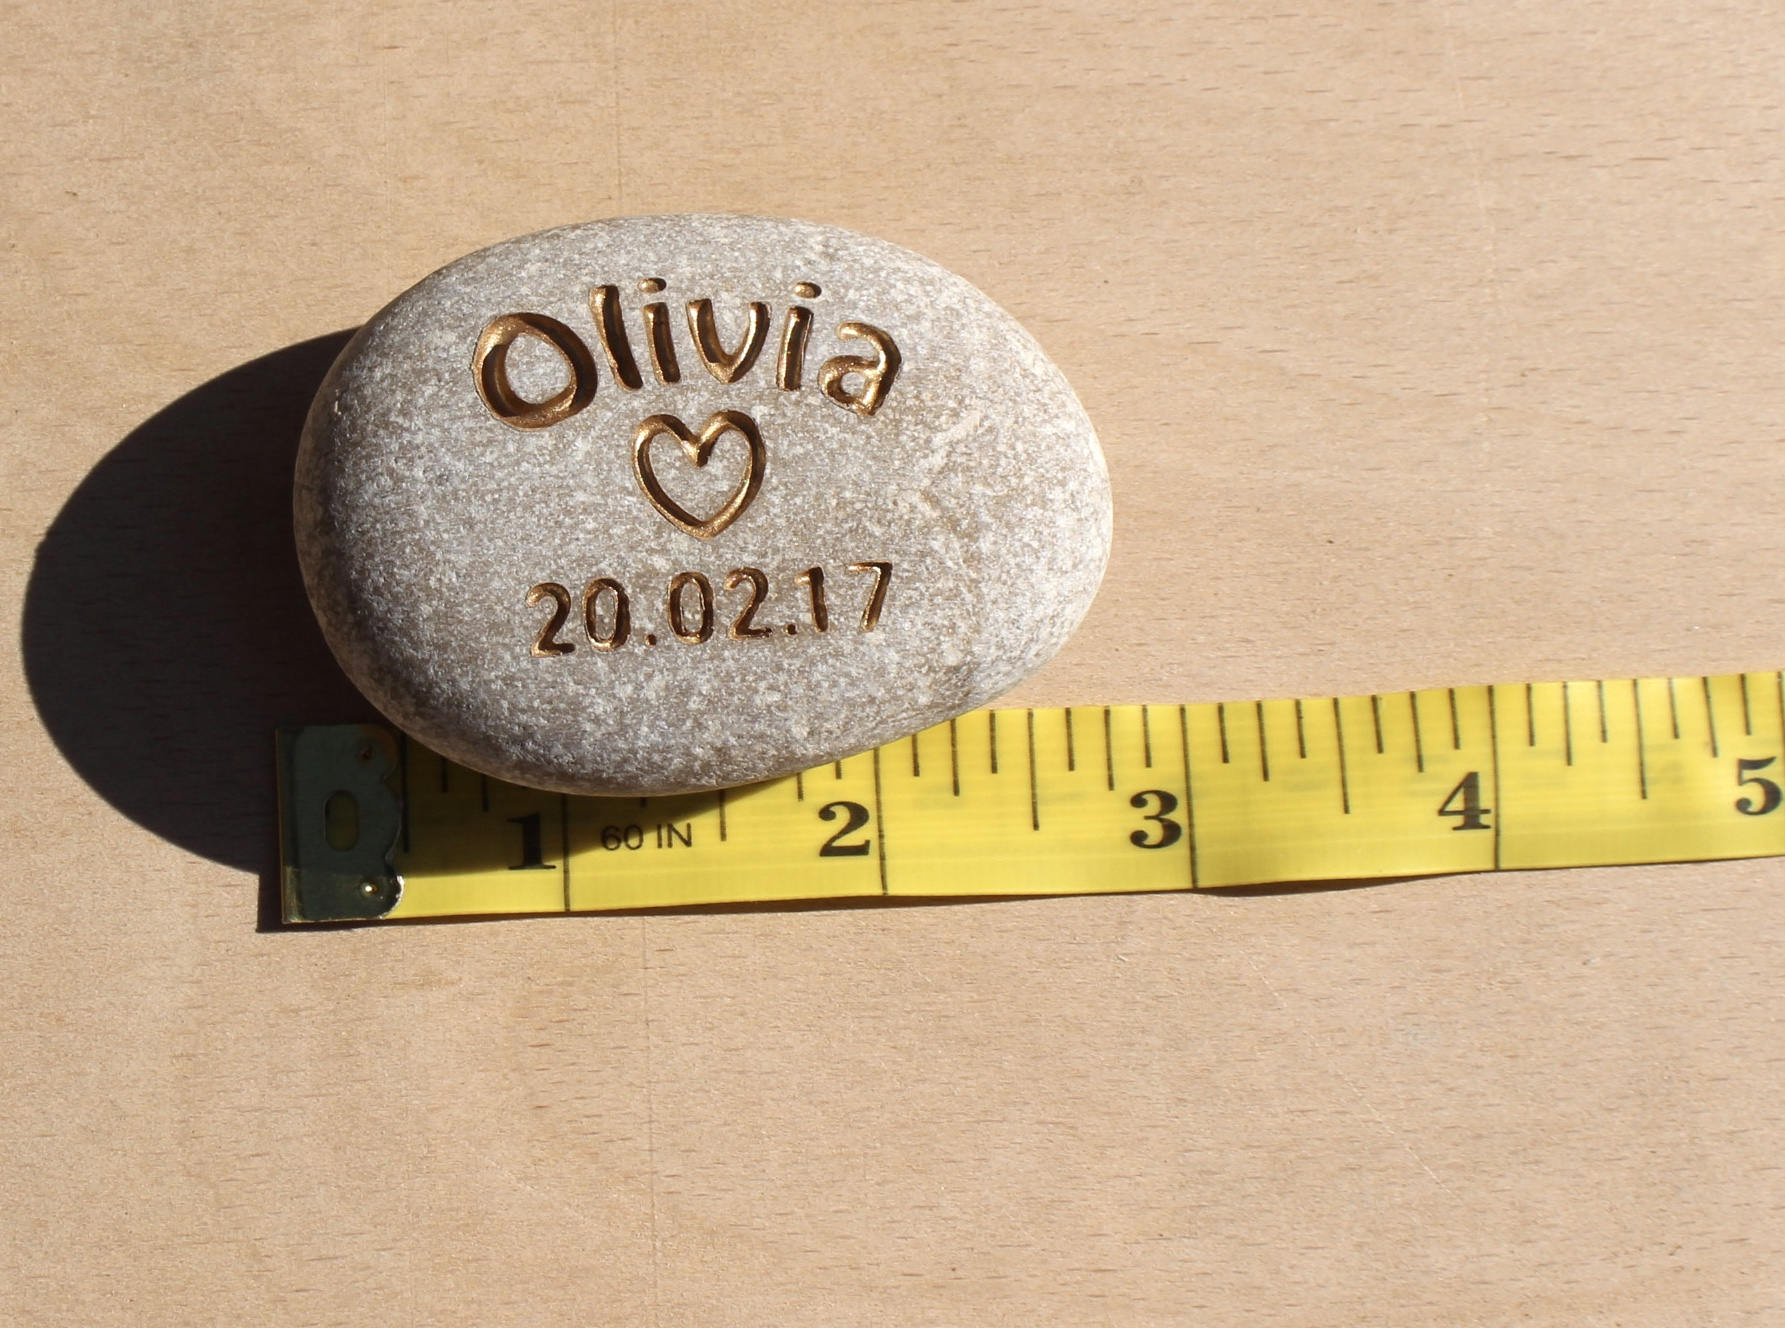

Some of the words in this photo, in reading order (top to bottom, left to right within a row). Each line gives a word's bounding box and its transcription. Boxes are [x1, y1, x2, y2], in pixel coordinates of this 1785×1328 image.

[472, 277, 902, 431] Olivia
[526, 561, 893, 657] 20.02.17
[1438, 771, 1492, 830] 4
[1734, 756, 1783, 816] 5
[508, 812, 557, 871] 1
[600, 822, 645, 851] 60
[656, 821, 693, 849] IN
[817, 800, 871, 858] 2
[1129, 789, 1183, 850] 3
